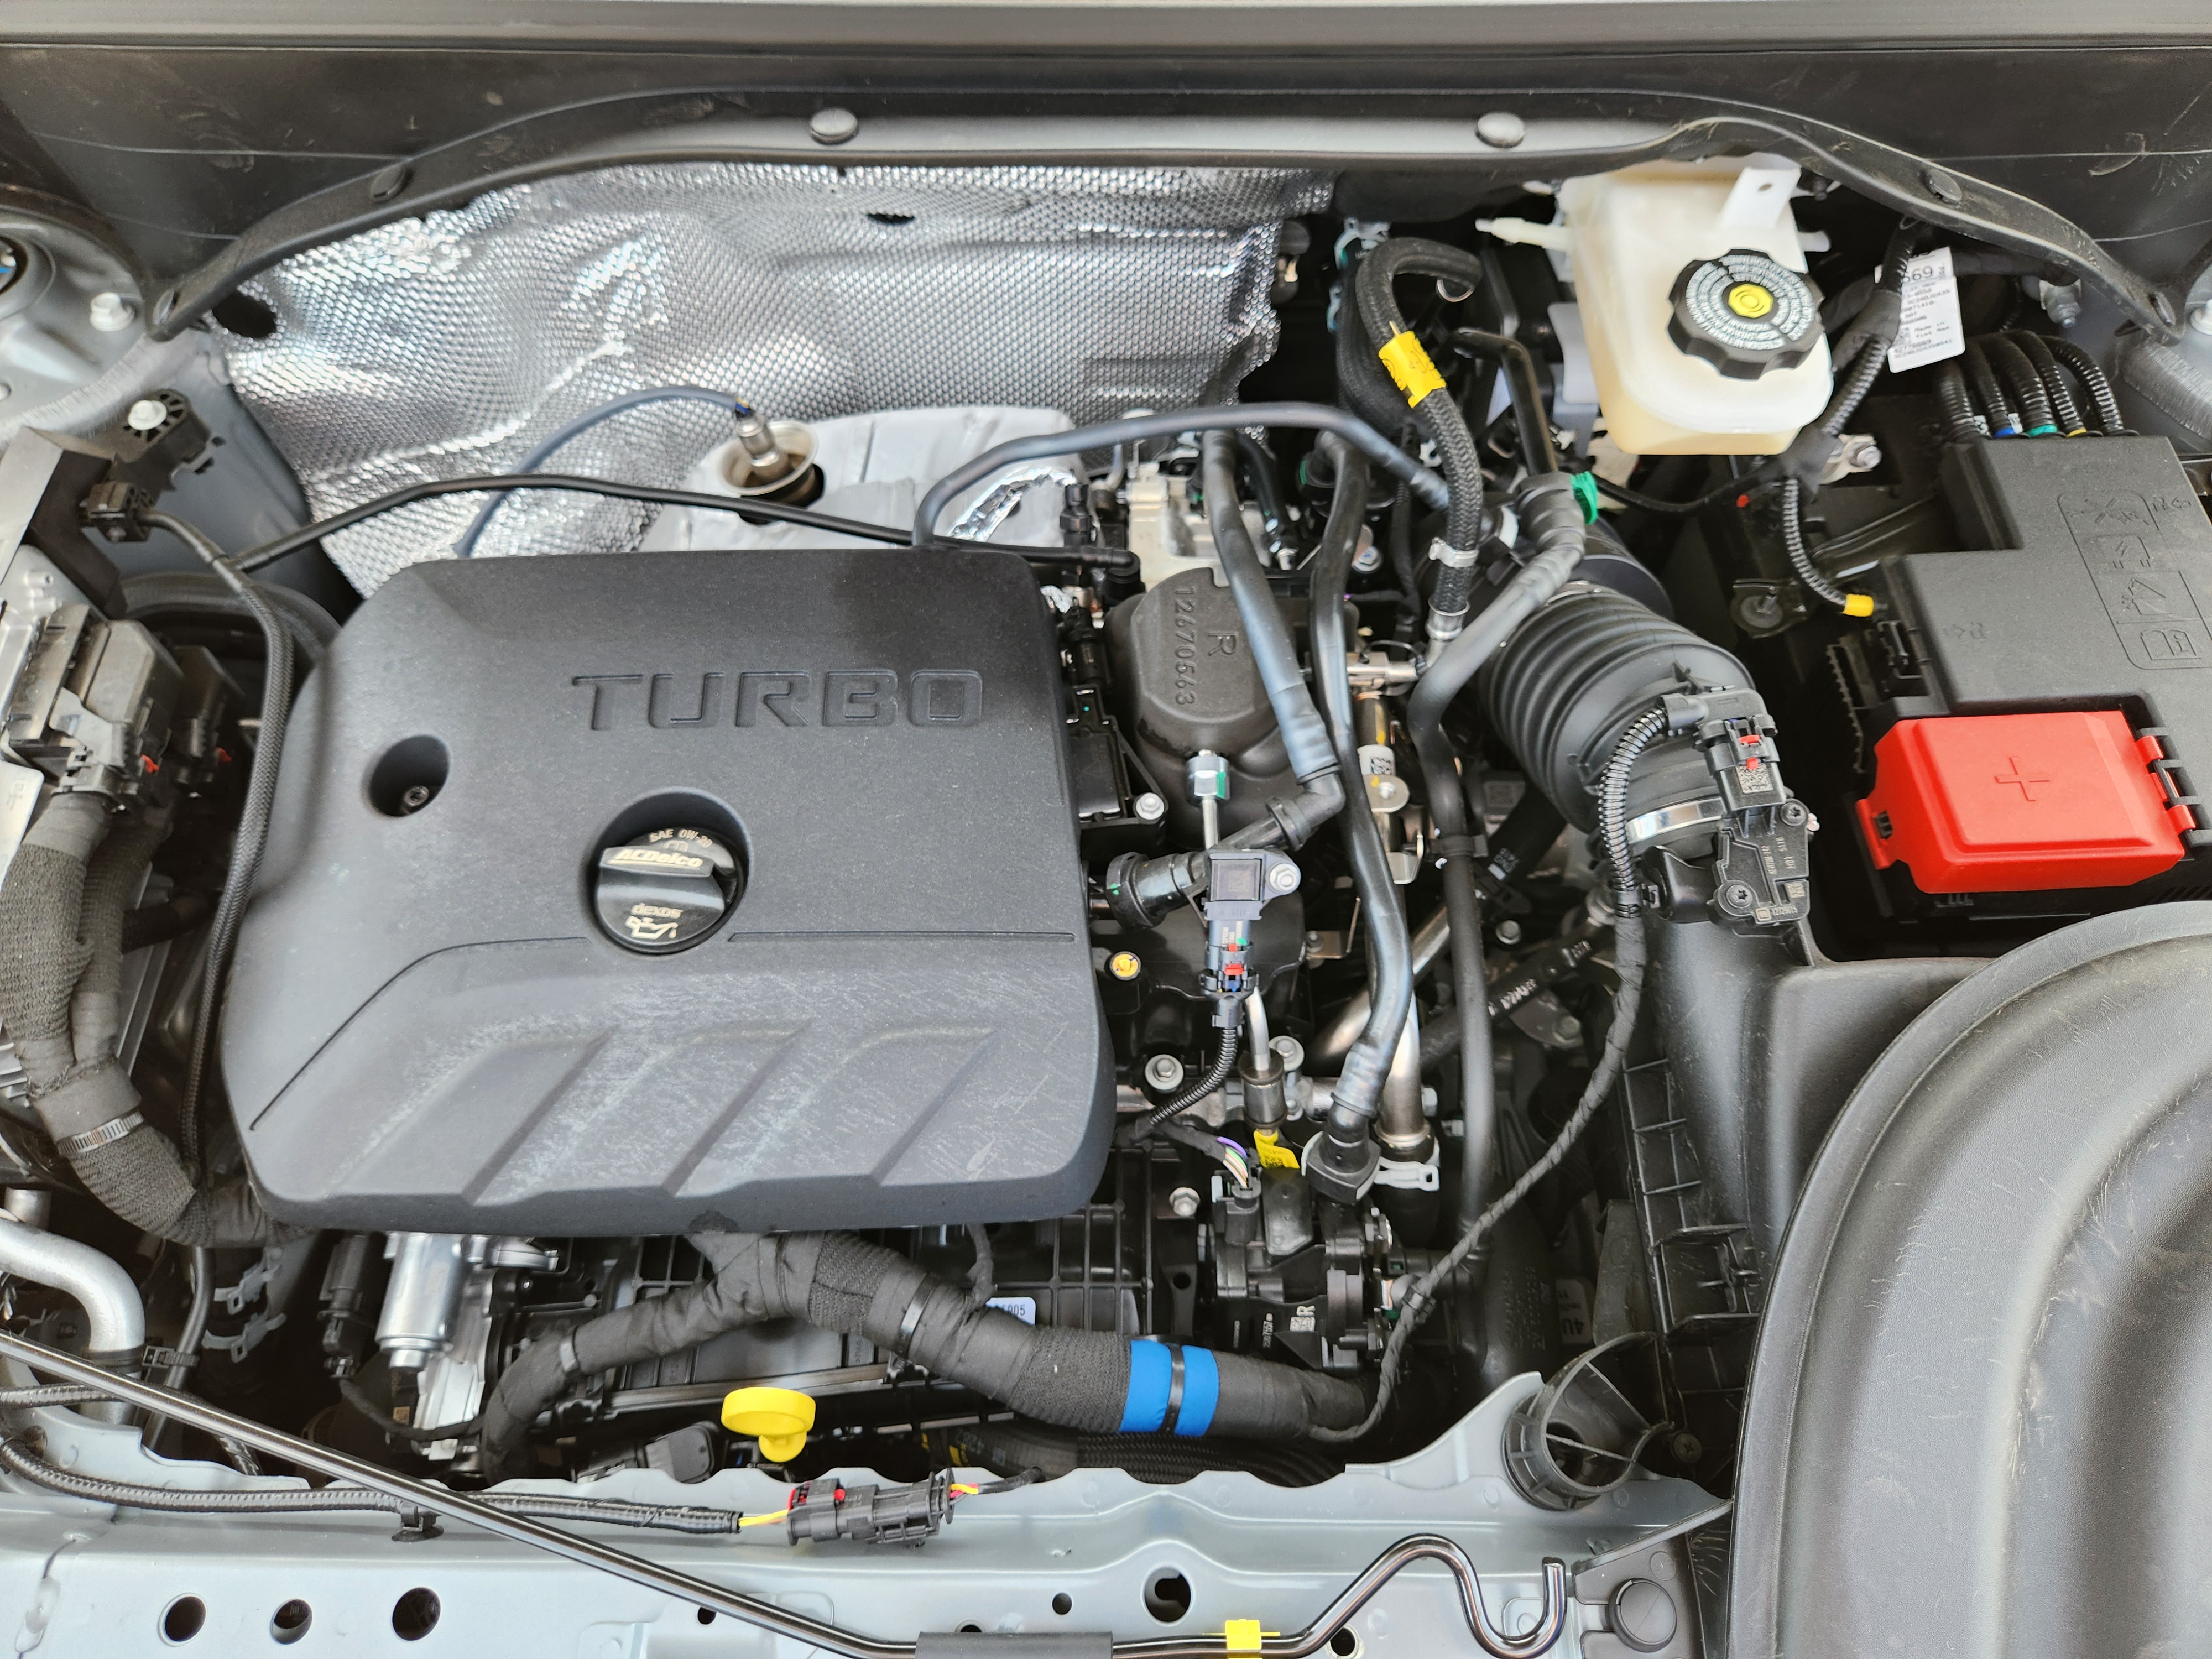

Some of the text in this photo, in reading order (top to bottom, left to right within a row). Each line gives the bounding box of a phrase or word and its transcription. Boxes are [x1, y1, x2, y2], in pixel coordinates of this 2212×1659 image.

[1175, 588, 1197, 705] 12670563
[1208, 631, 1238, 656] R
[571, 670, 983, 730] TURBO
[649, 828, 713, 848] SAE 0W-20
[610, 848, 703, 869] ACDelco
[630, 902, 684, 919] dexos
[1297, 1305, 1316, 1318] R
